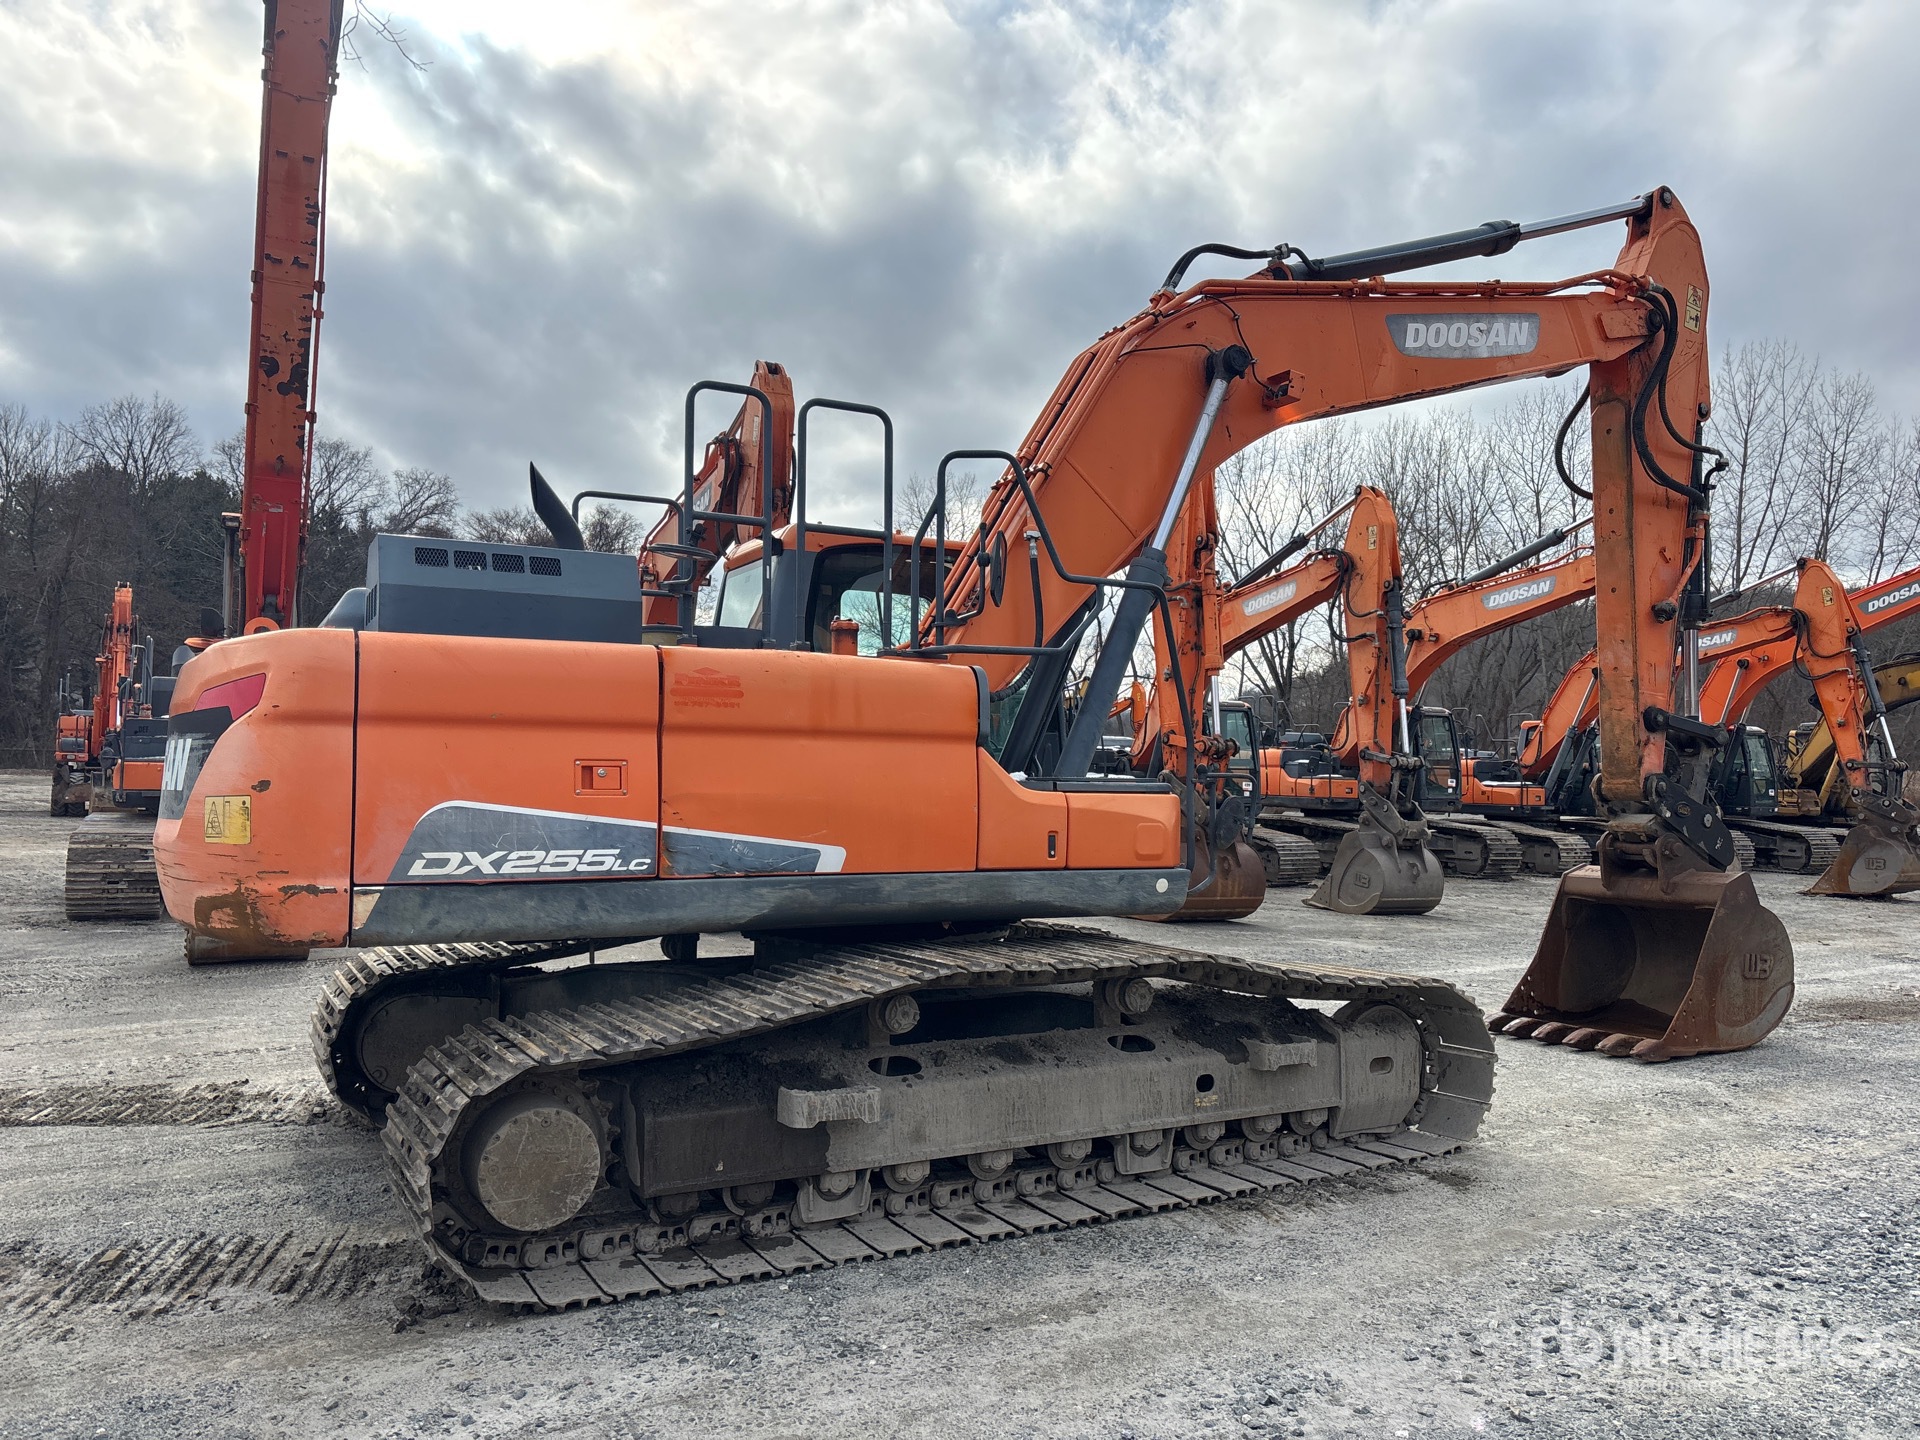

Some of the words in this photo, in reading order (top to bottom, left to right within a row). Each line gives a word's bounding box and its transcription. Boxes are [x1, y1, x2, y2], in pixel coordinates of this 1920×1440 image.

[1404, 322, 1529, 348] DOOSAN
[1248, 584, 1293, 612] DOOSAN
[1489, 580, 1551, 607] DOOSAN
